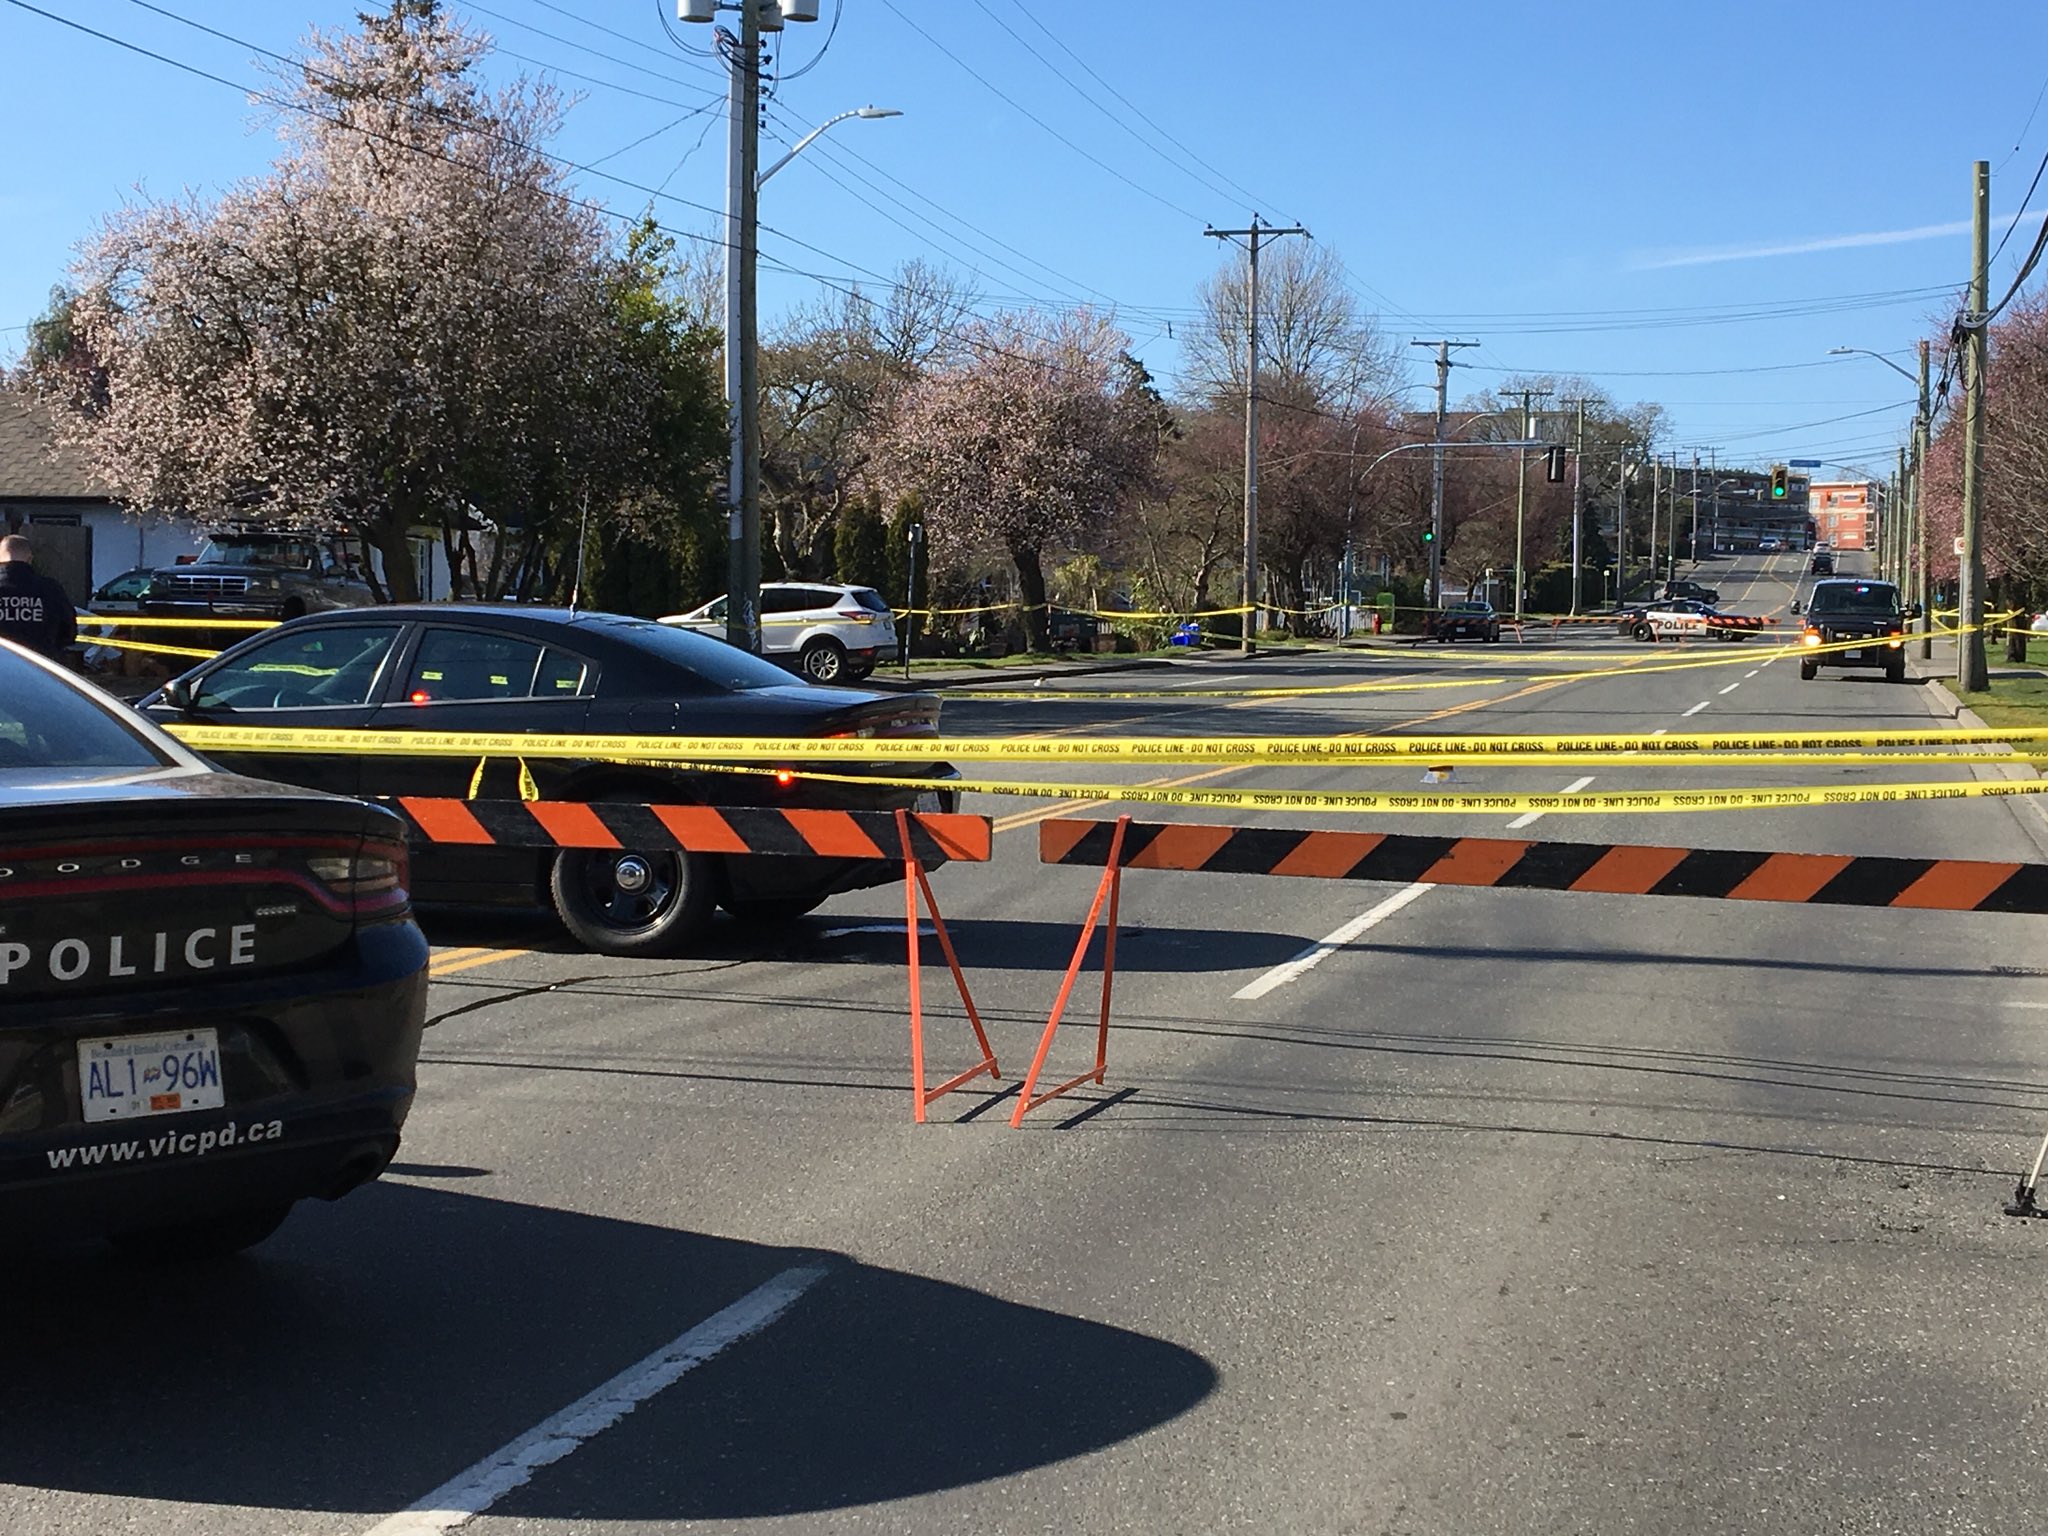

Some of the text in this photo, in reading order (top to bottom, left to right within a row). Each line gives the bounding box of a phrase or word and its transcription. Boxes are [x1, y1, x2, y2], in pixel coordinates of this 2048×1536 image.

[0, 596, 43, 607] TORIA
[411, 737, 514, 747] POLICE LINE DO NOT CROSS
[522, 739, 626, 750] POLICE LINE DO NOT CROSS
[636, 741, 744, 750] POLICE LINE DO NOT CROSS
[753, 742, 865, 752] POLICE LINE DO NOT CROSS
[874, 743, 990, 752] POLICE LINE DO NOT CROSS
[1267, 742, 1396, 753] POLICE LINE DO NOT CROSS
[1408, 741, 1544, 752] POLICE LINE DO NOT CROSS
[1556, 740, 1698, 752] POLICE LINE DO NOT CROSS
[1712, 739, 1862, 750] POLICE LINE DO NOT CROSS
[1000, 743, 1120, 753] POLICE LINE DO NOT CROSS
[1132, 743, 1255, 753] POLICE LINE DO NOT CROSS
[1121, 791, 1242, 804] POLICE LINE DO NOT CROSS
[1253, 794, 1377, 806] POLICE LINE DO NOT CROSS
[1673, 794, 1810, 805] POLICE LINE DO NOT CROSS
[1824, 788, 1967, 801] POLICE LINE DO NOT CROSS
[1388, 797, 1516, 807] POLICE LINE DO NOT CROSS
[1528, 796, 1660, 807] POLICE LINE DO NOT CROSS
[0, 924, 256, 984] POLICE
[163, 1050, 218, 1092] 96W
[47, 1119, 283, 1169] www.vicpd.ca
